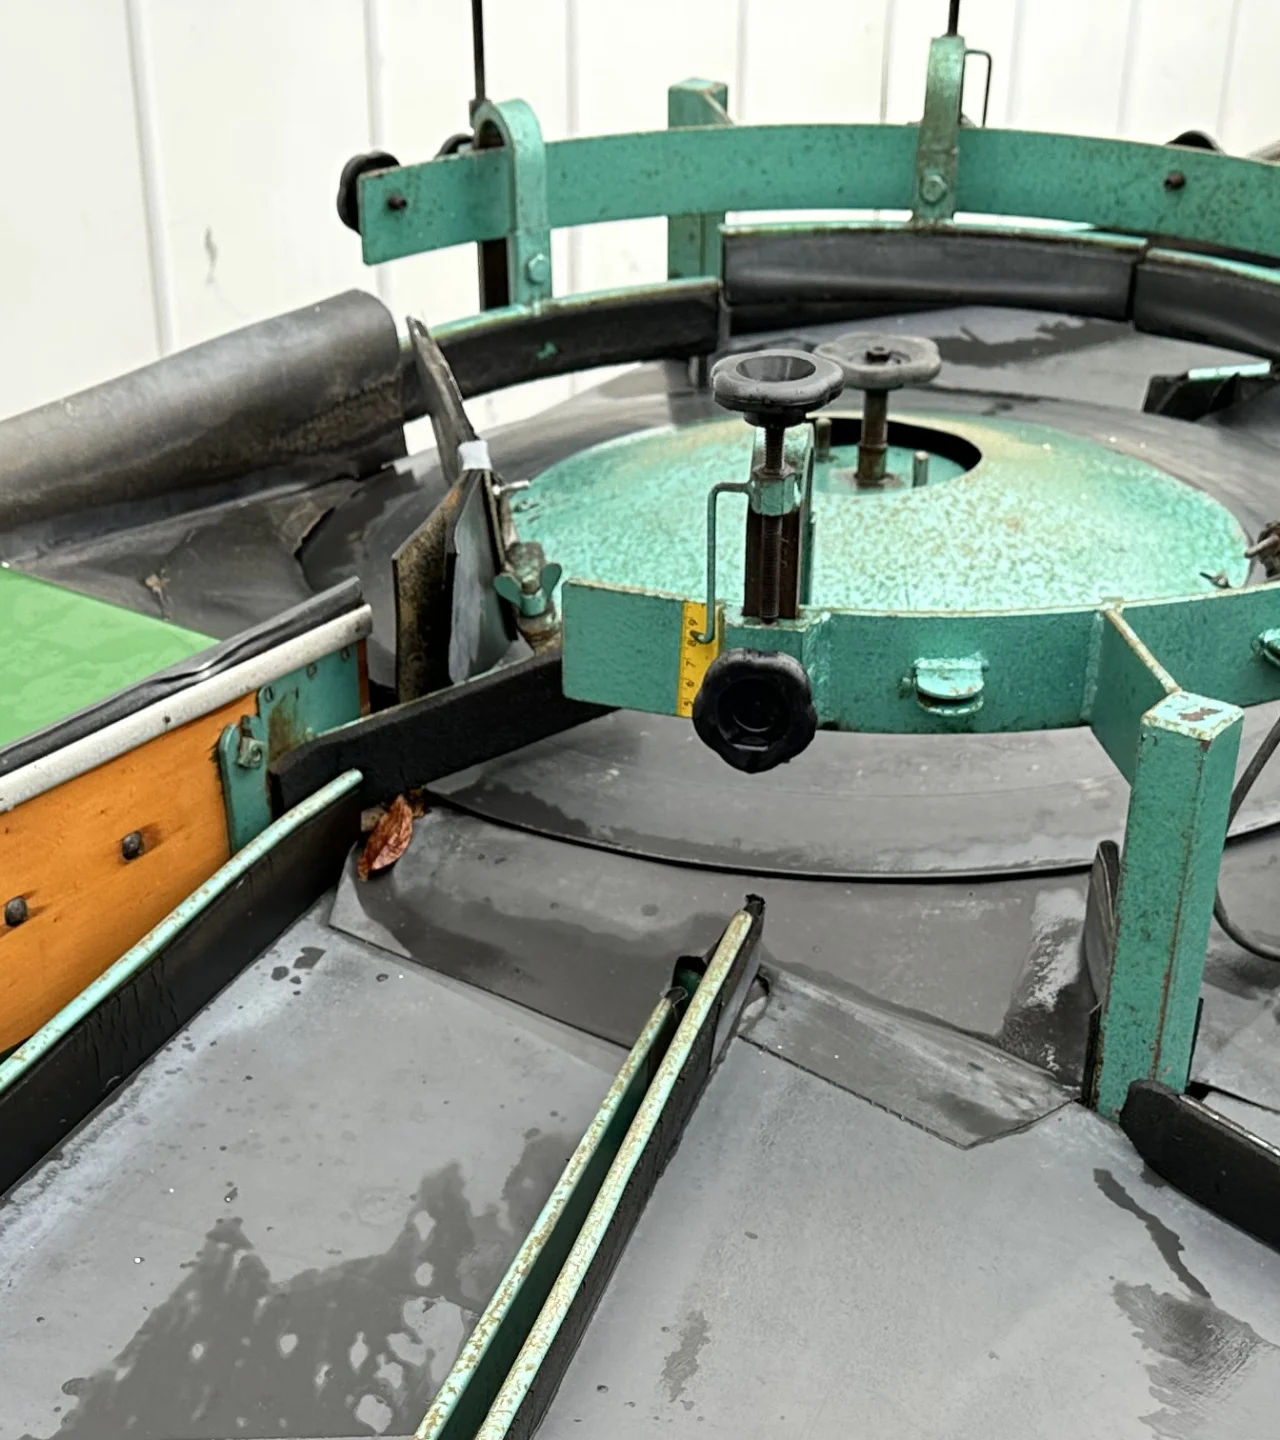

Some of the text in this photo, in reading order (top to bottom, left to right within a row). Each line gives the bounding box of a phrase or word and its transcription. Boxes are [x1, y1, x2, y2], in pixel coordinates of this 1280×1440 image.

[688, 618, 698, 627] 9
[685, 660, 696, 668] 7
[685, 680, 695, 688] 6
